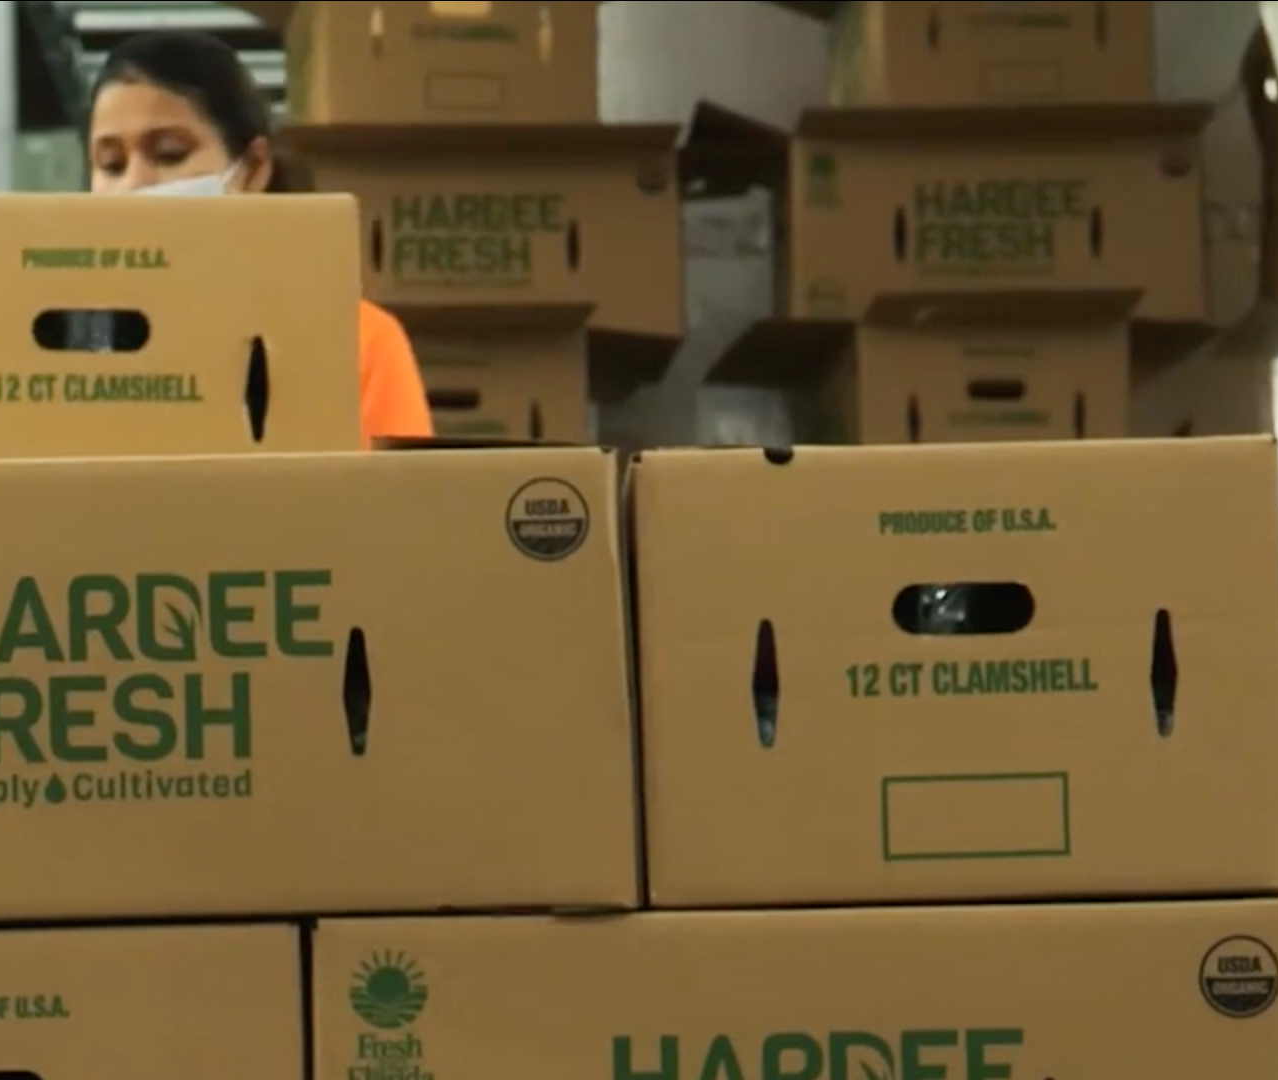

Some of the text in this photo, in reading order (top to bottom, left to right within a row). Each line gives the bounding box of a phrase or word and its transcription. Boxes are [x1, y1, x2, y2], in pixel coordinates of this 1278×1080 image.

[23, 248, 170, 269] PRODUCE OF U.S.A.
[392, 233, 531, 273] FRESH
[28, 375, 57, 401] CT
[63, 373, 203, 402] CLAMSHELL
[525, 499, 570, 516] USDA
[879, 507, 1057, 534] PRODUCE OF U.S.A.
[847, 659, 1097, 697] 12 CT CLAMSHELL
[73, 770, 251, 801] Cultivated
[1218, 956, 1262, 974] USDA
[15, 996, 69, 1018] U.S.A.
[358, 1033, 422, 1059] Fresh
